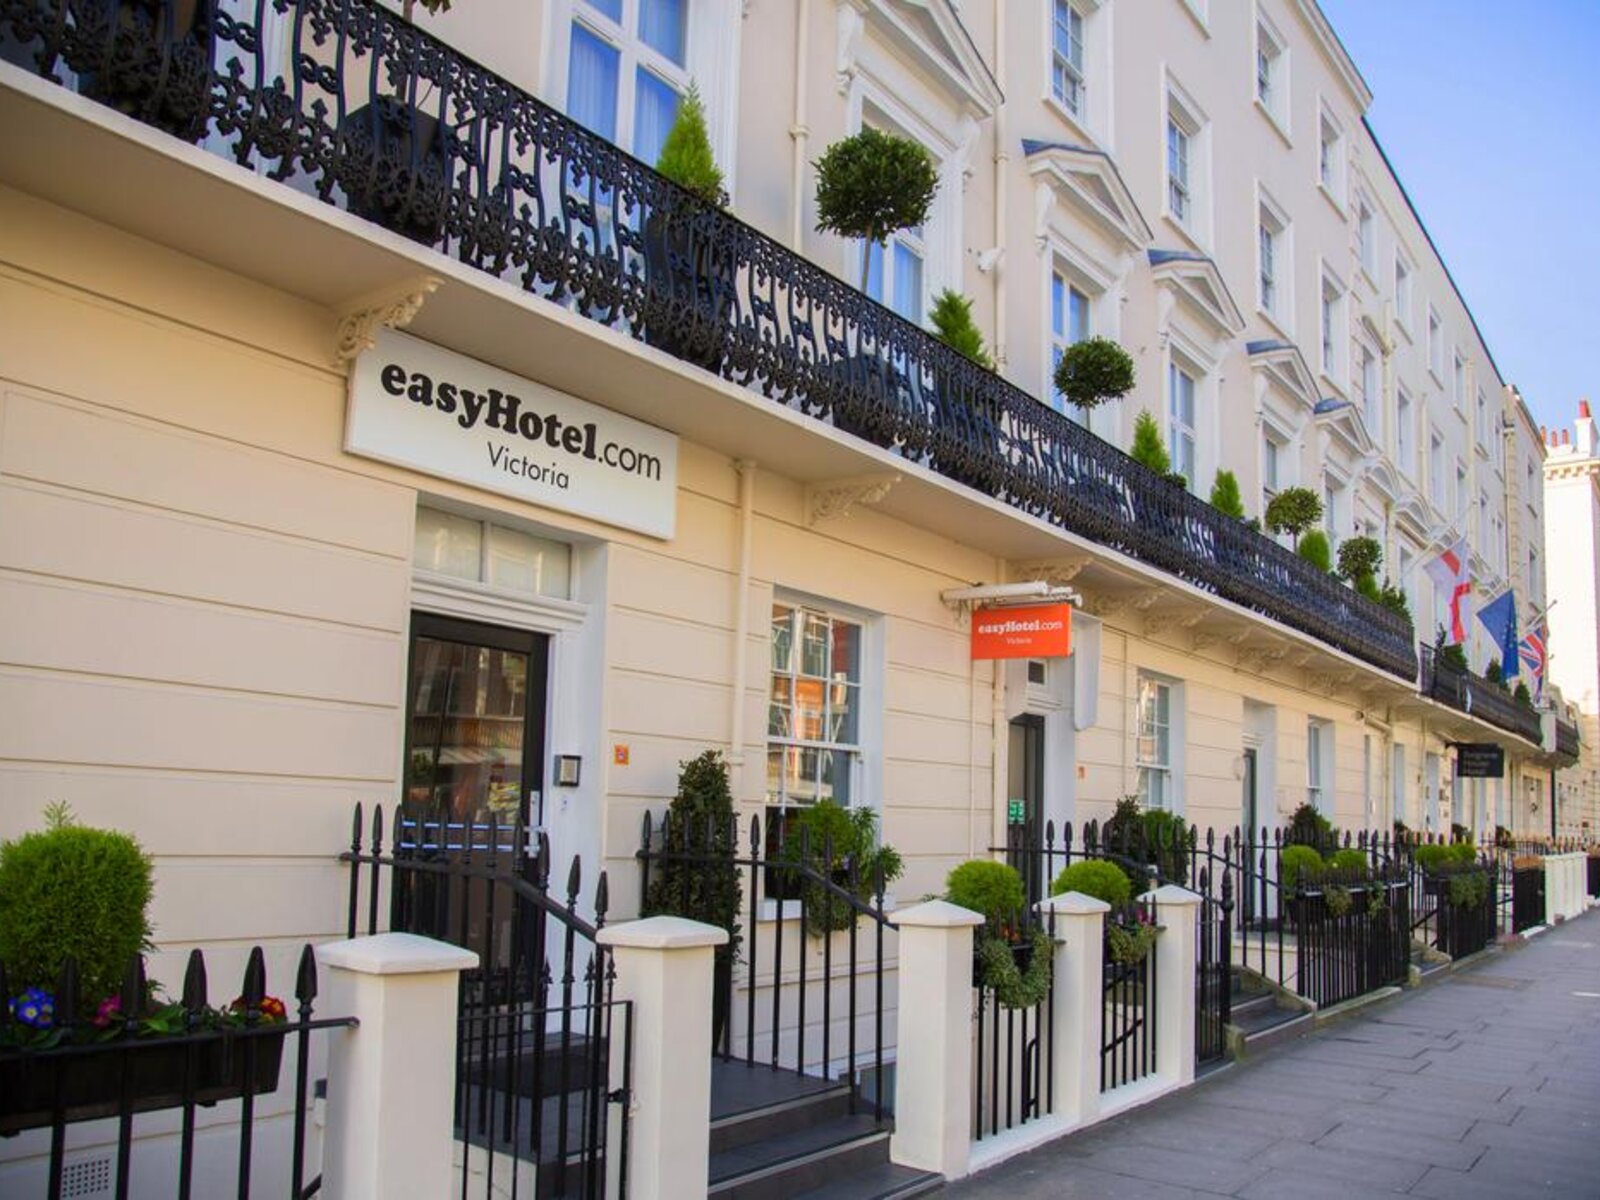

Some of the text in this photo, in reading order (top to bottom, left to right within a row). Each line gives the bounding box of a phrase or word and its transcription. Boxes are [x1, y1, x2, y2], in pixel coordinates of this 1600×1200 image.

[381, 363, 661, 481] easyHotel.com
[487, 441, 570, 489] Victoria
[978, 619, 1063, 635] easyHotel.com
